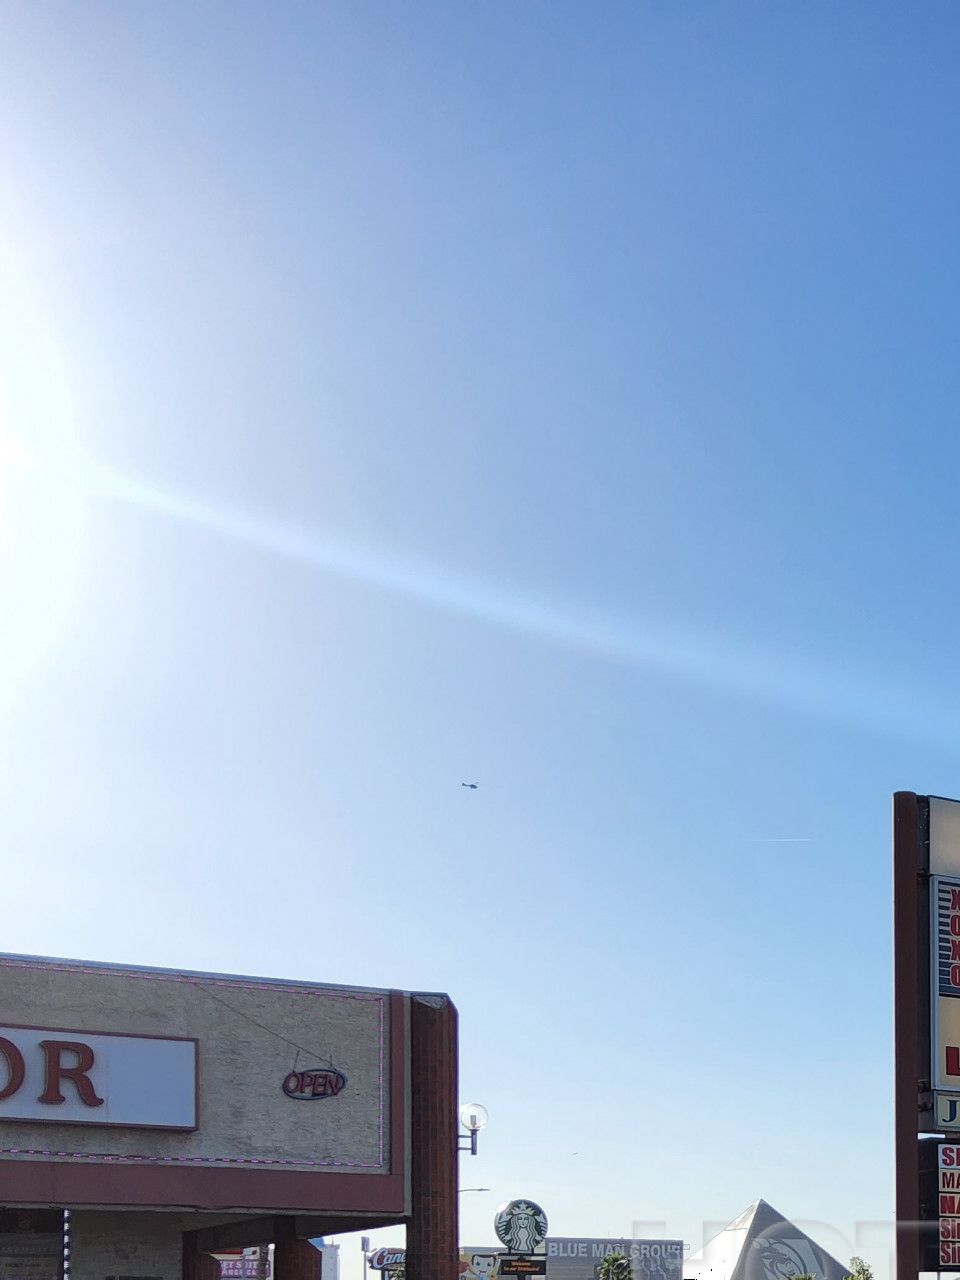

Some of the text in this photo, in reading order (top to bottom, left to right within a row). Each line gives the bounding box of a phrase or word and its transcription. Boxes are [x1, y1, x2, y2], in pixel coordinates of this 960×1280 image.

[284, 1071, 342, 1097] OPEN
[547, 1241, 588, 1257] BLUE
[591, 1243, 625, 1258] MAN
